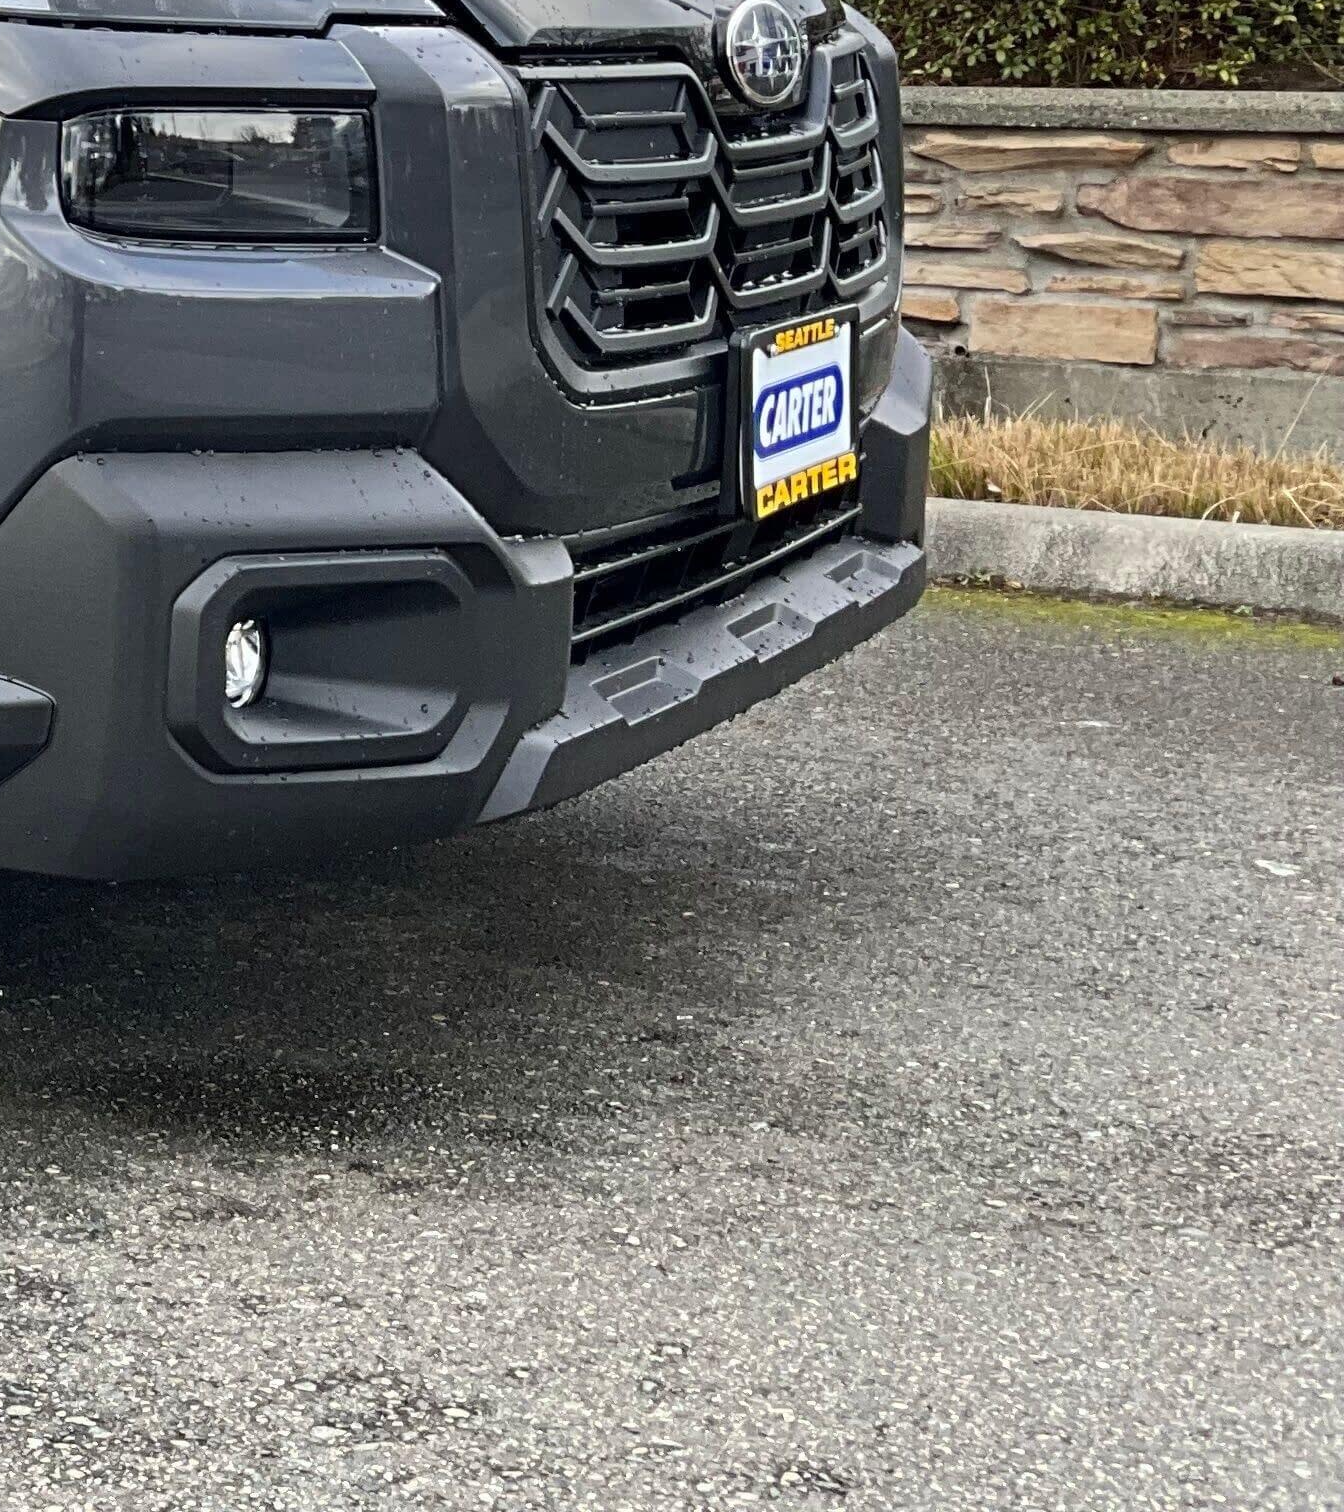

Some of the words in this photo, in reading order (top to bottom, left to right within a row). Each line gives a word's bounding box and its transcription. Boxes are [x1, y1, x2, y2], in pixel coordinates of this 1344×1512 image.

[775, 318, 836, 354] SEATTLE
[760, 377, 836, 447] CARTER
[756, 451, 858, 519] CARTER
